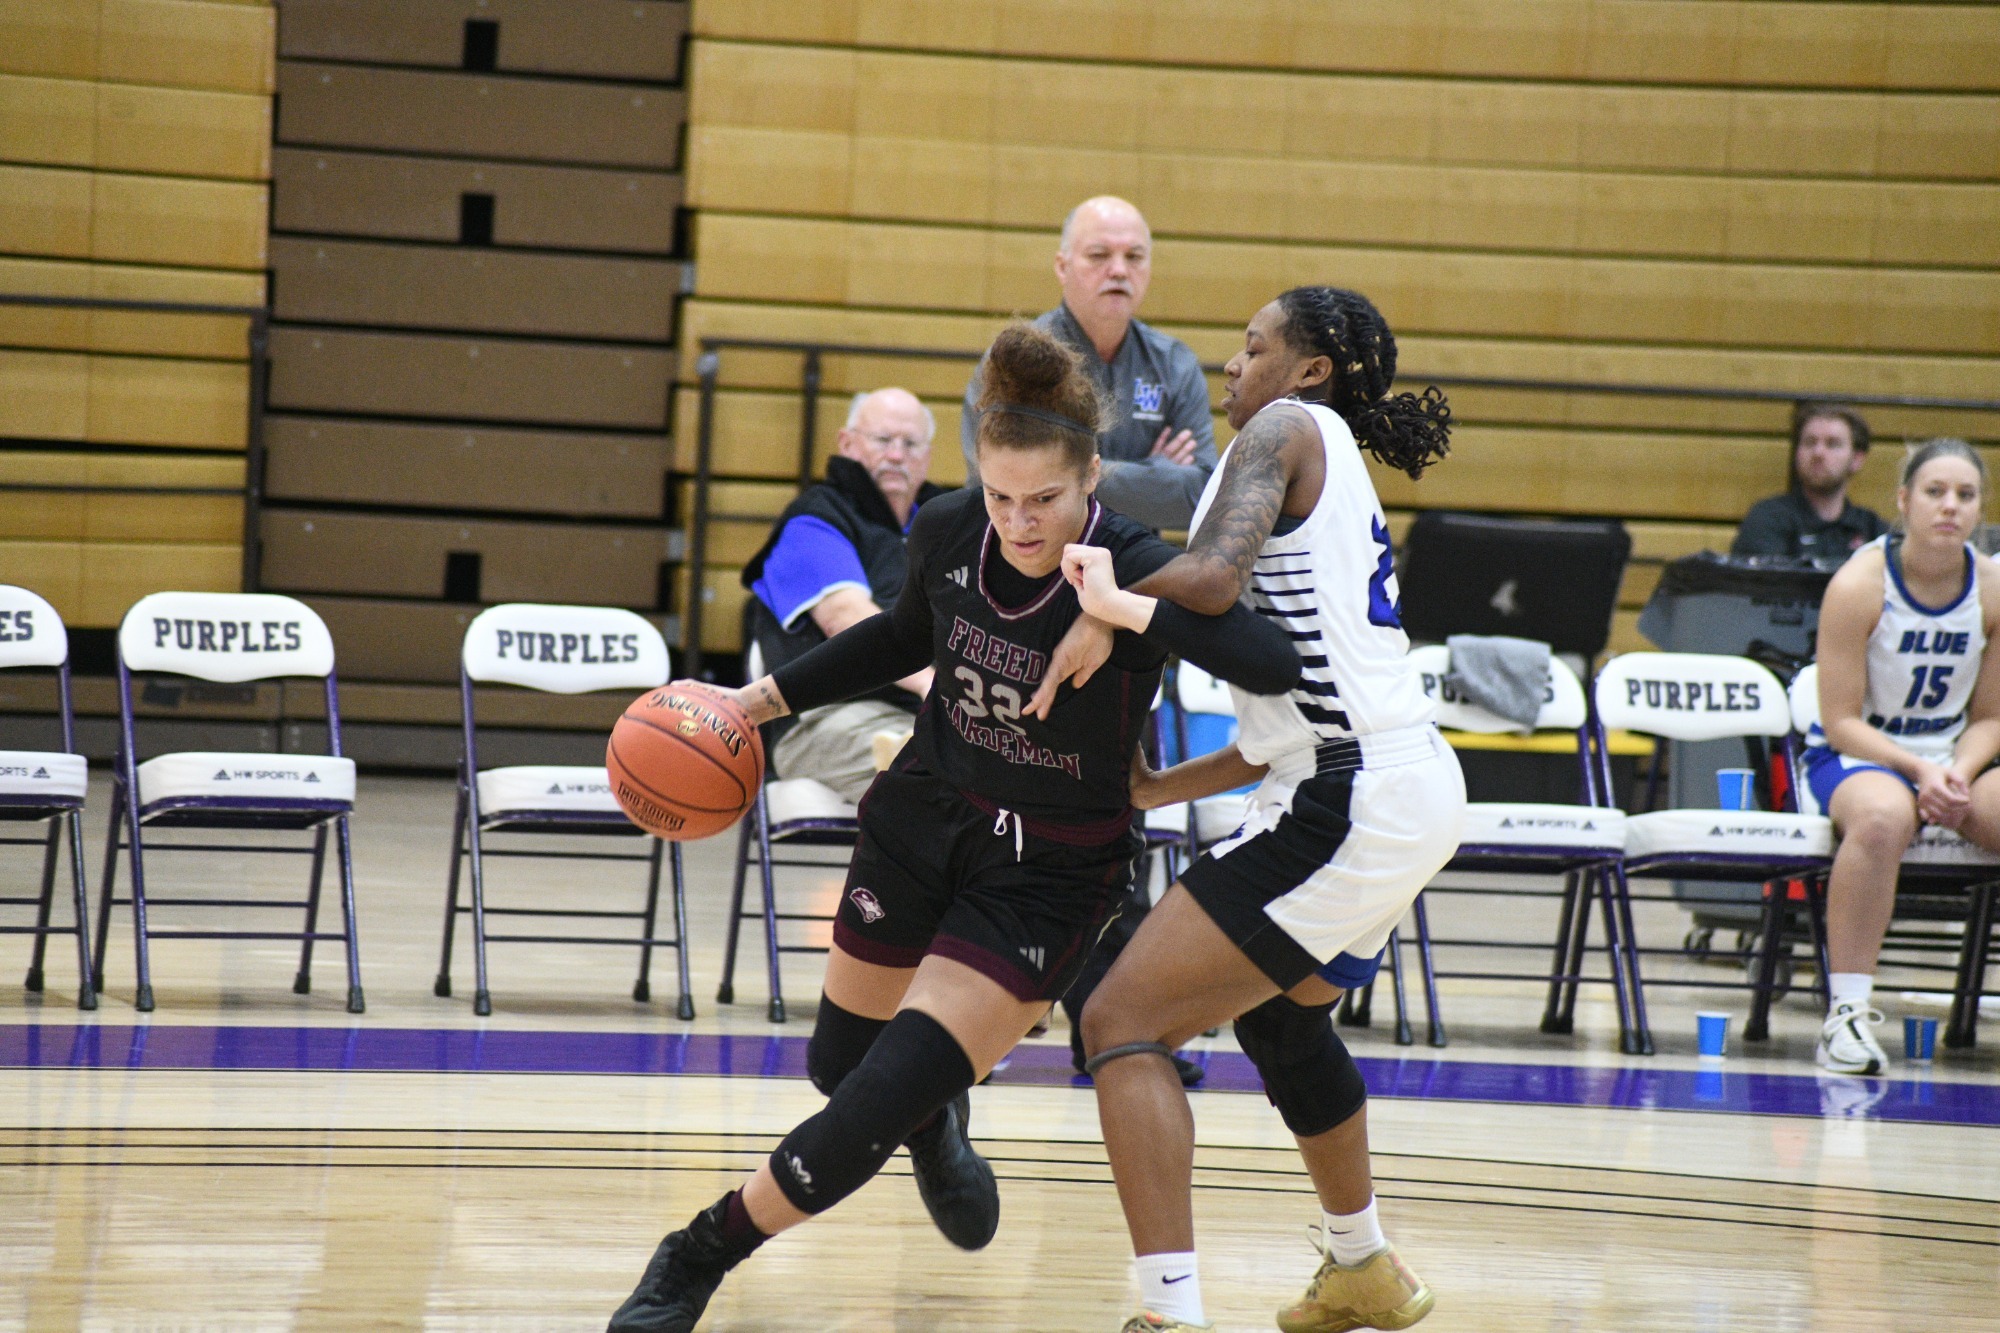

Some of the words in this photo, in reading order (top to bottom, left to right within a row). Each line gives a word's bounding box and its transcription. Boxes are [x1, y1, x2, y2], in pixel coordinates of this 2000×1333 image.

[153, 617, 302, 653] PURPLES
[496, 629, 639, 664] PURPLES
[948, 616, 1047, 685] FREED
[1898, 630, 1970, 656] BLUE
[954, 665, 1027, 736] 32
[1625, 677, 1762, 713] PURPLES
[1904, 665, 1954, 709] 15
[647, 691, 748, 759] SPALDING
[233, 770, 254, 780] HW
[255, 770, 300, 781] SPORTS
[1536, 818, 1577, 829] SPORTS
[1746, 826, 1786, 838] SPORTS
